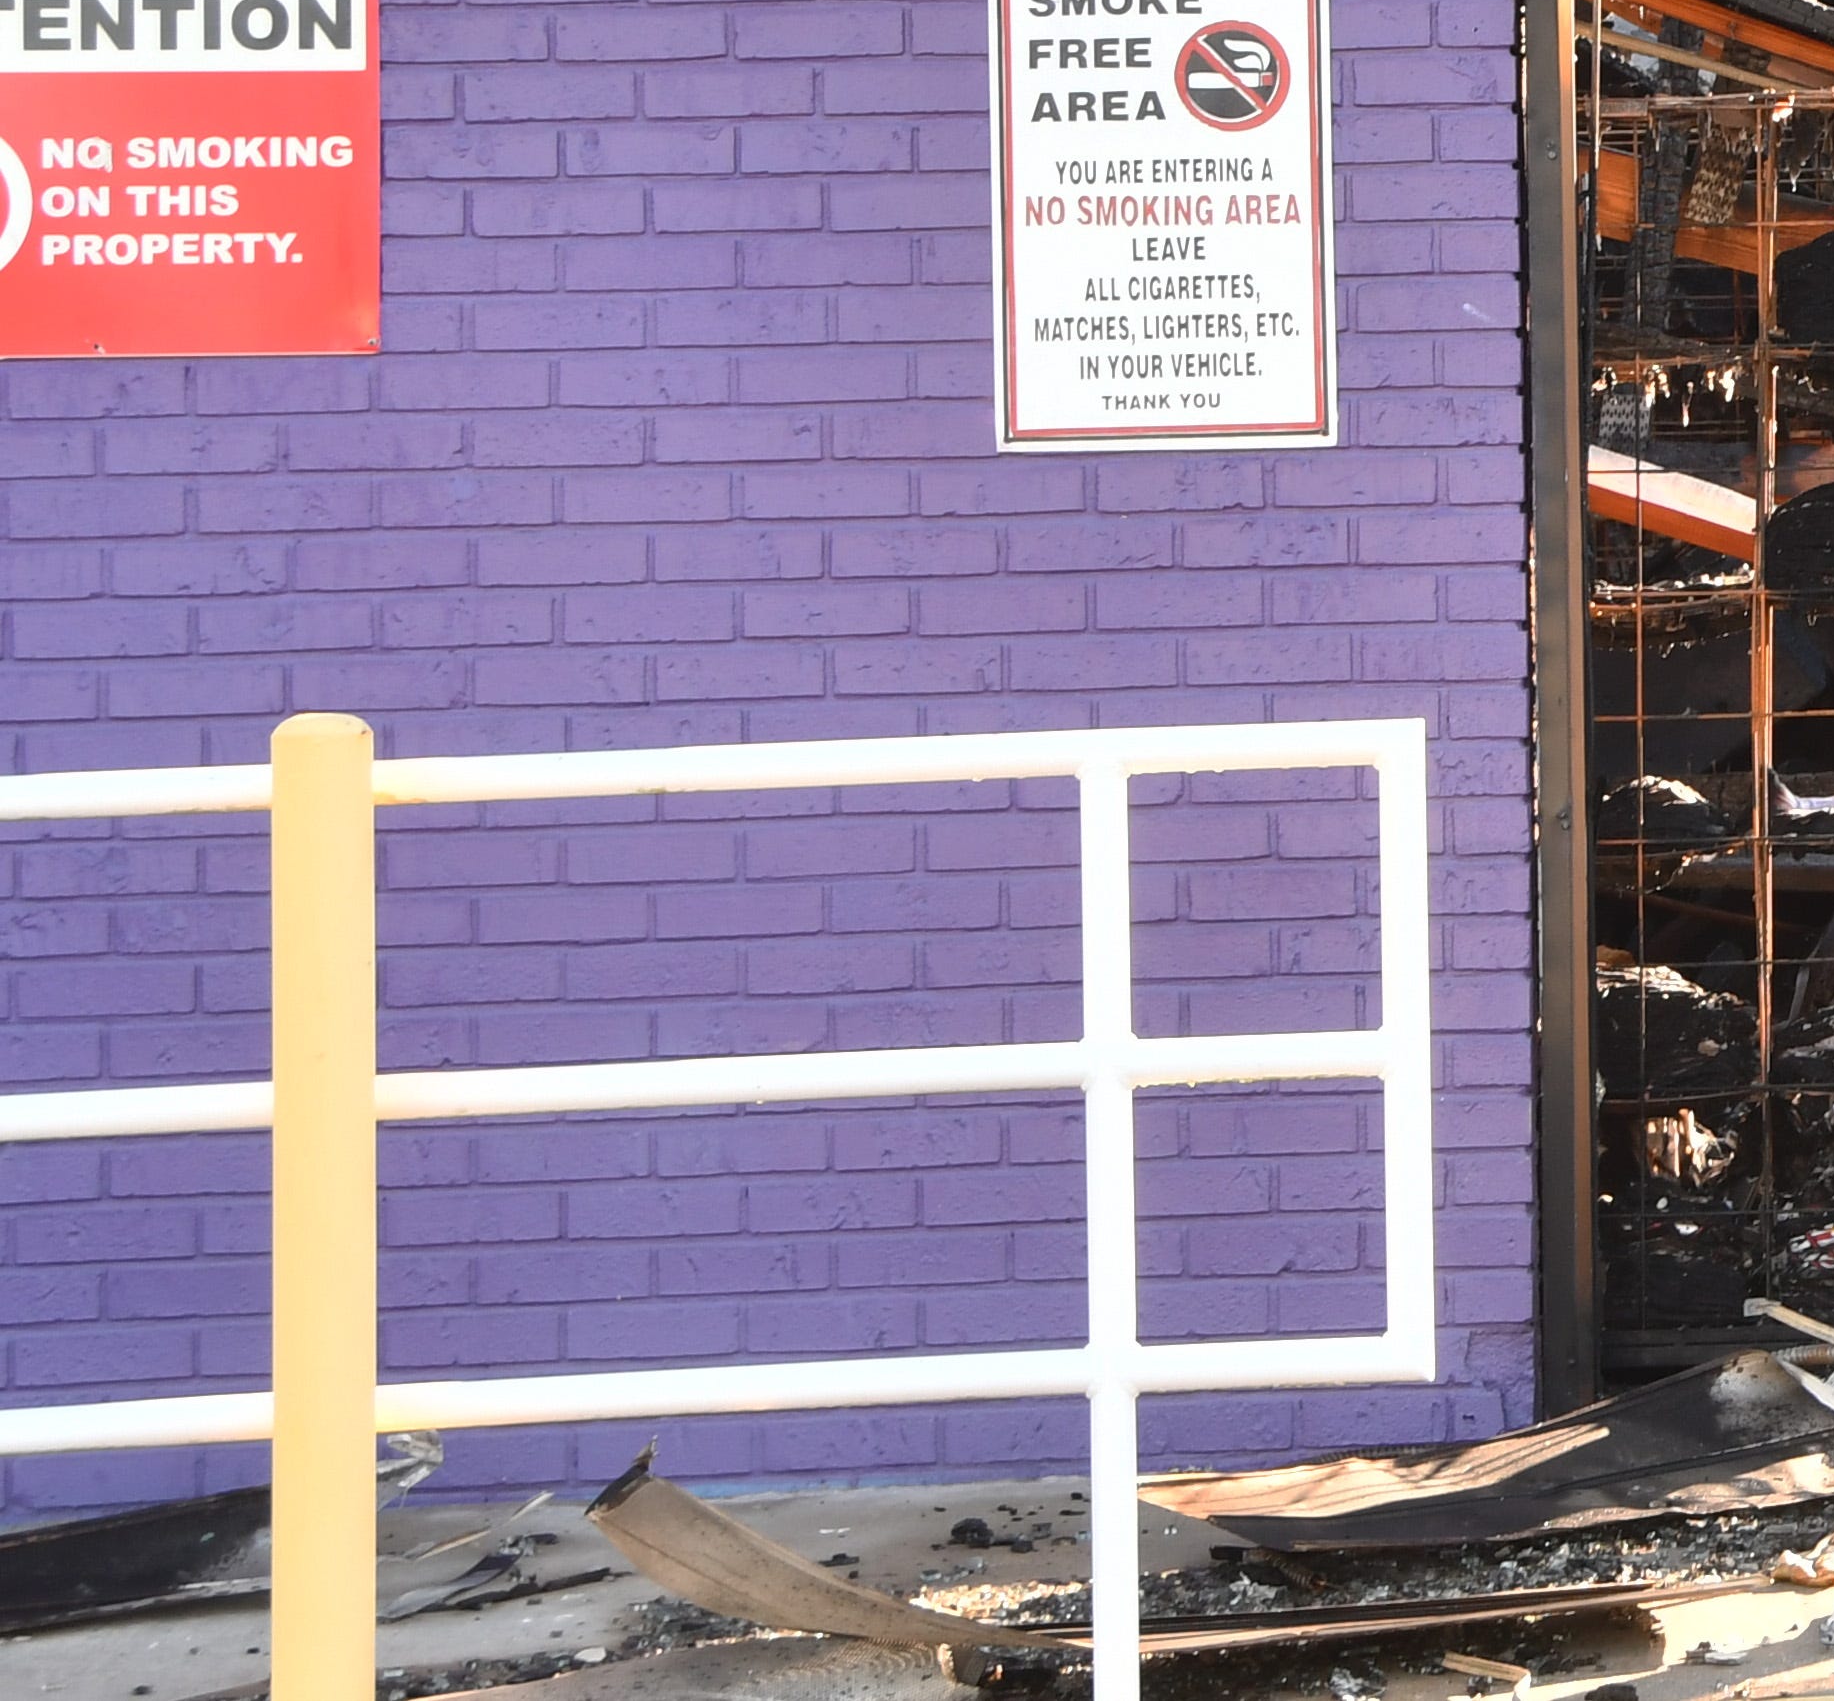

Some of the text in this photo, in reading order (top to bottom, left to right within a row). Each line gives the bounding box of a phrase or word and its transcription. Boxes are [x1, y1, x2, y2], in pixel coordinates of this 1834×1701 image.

[1028, 37, 1153, 70] FREE
[1030, 90, 1167, 123] AREA
[41, 136, 354, 171] NO SMOKING
[1055, 157, 1273, 185] YOU ARE ENTERING A
[41, 185, 240, 217] ON THIS
[1025, 193, 1301, 227] NO SMOKING AREA
[41, 232, 303, 266] PROPERTY.
[1132, 236, 1206, 262] LEAVE
[1084, 273, 1260, 304] ALL CIGARETTES,
[1034, 311, 1300, 345] MATCHES, LIGHTERS, ETC.
[1079, 351, 1263, 380] IN YOUR VEHICLE.
[1101, 392, 1221, 411] THANK YOU
